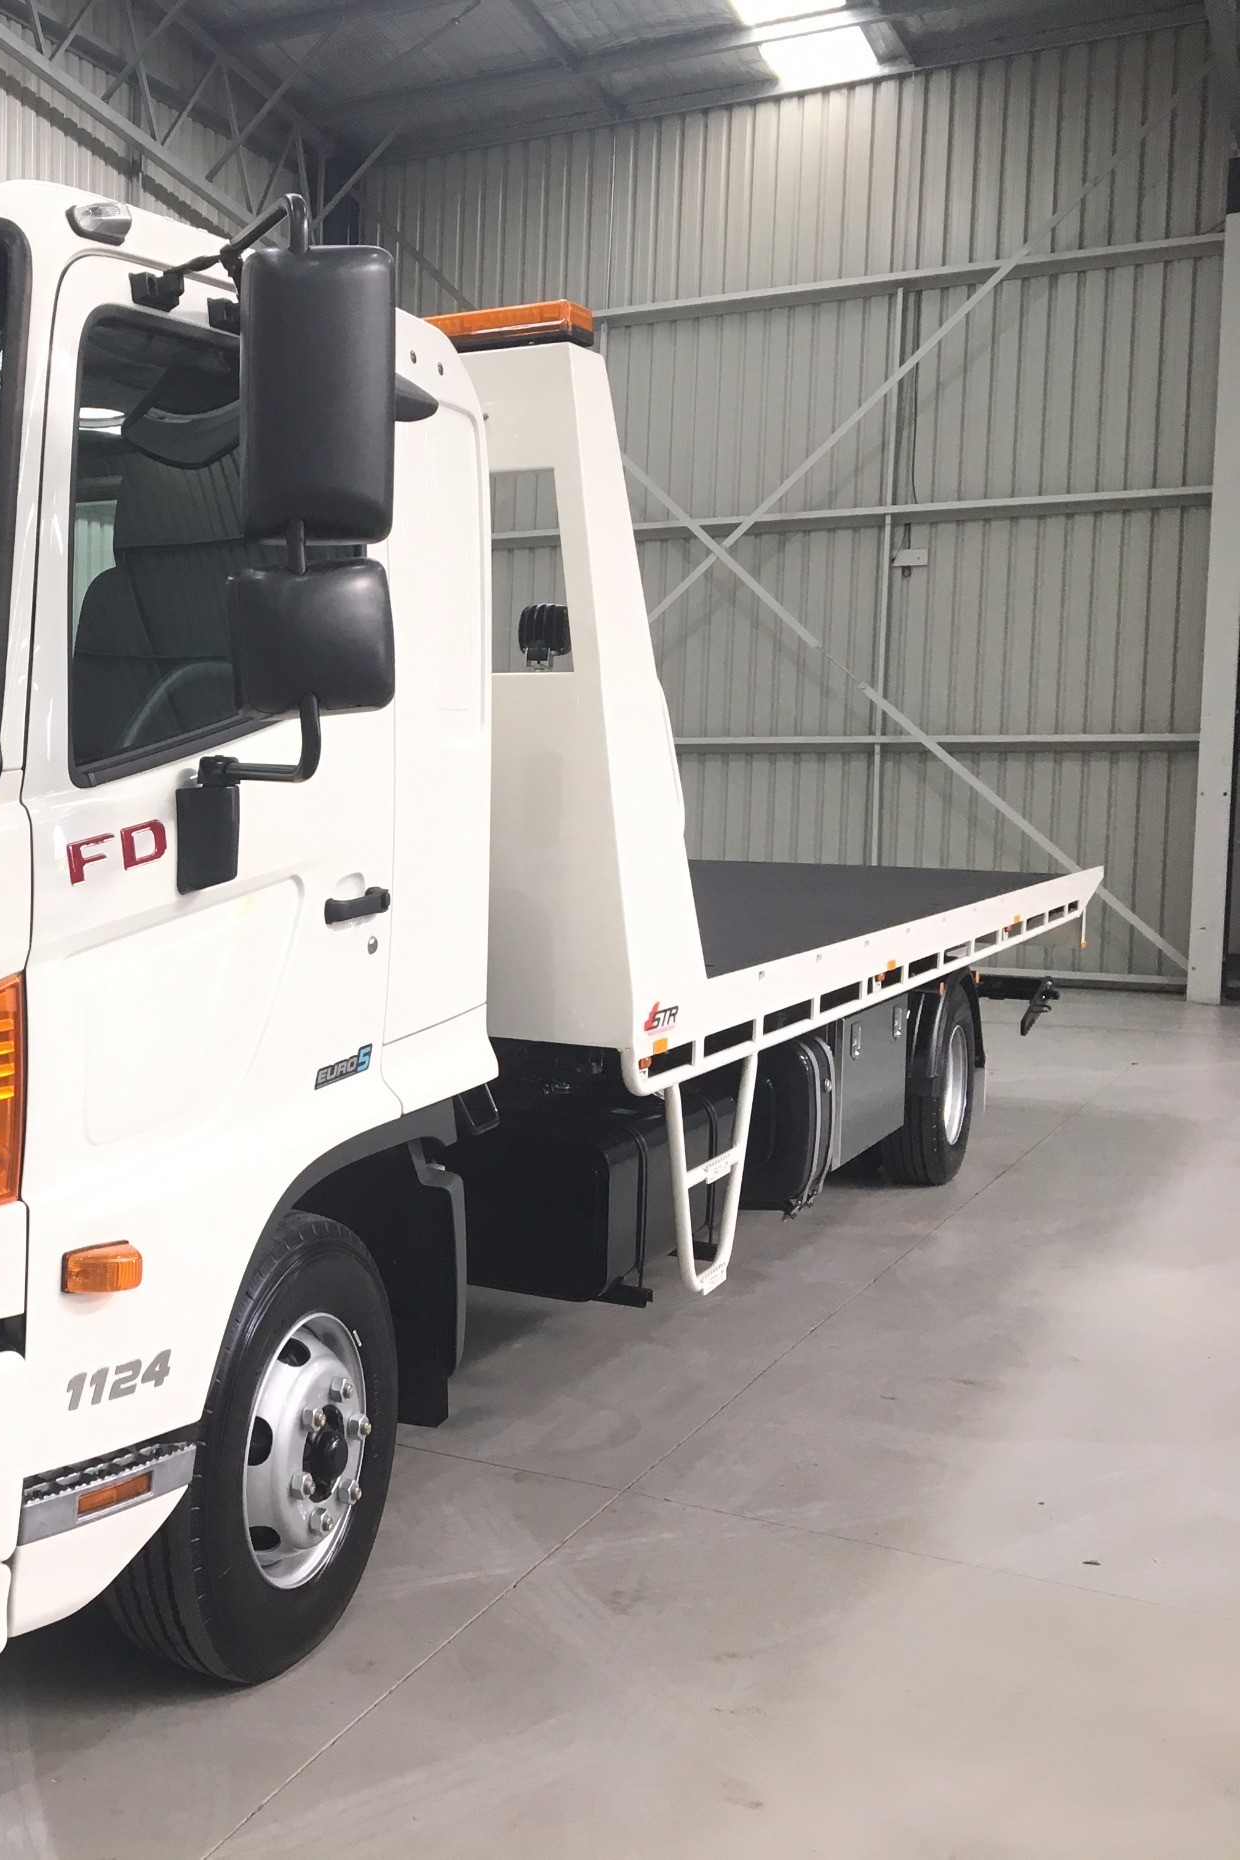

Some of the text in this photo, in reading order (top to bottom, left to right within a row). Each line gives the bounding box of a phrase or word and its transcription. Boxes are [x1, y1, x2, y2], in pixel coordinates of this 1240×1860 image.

[66, 818, 167, 886] FD
[644, 1005, 679, 1031] STR
[66, 1349, 172, 1411] 1124
